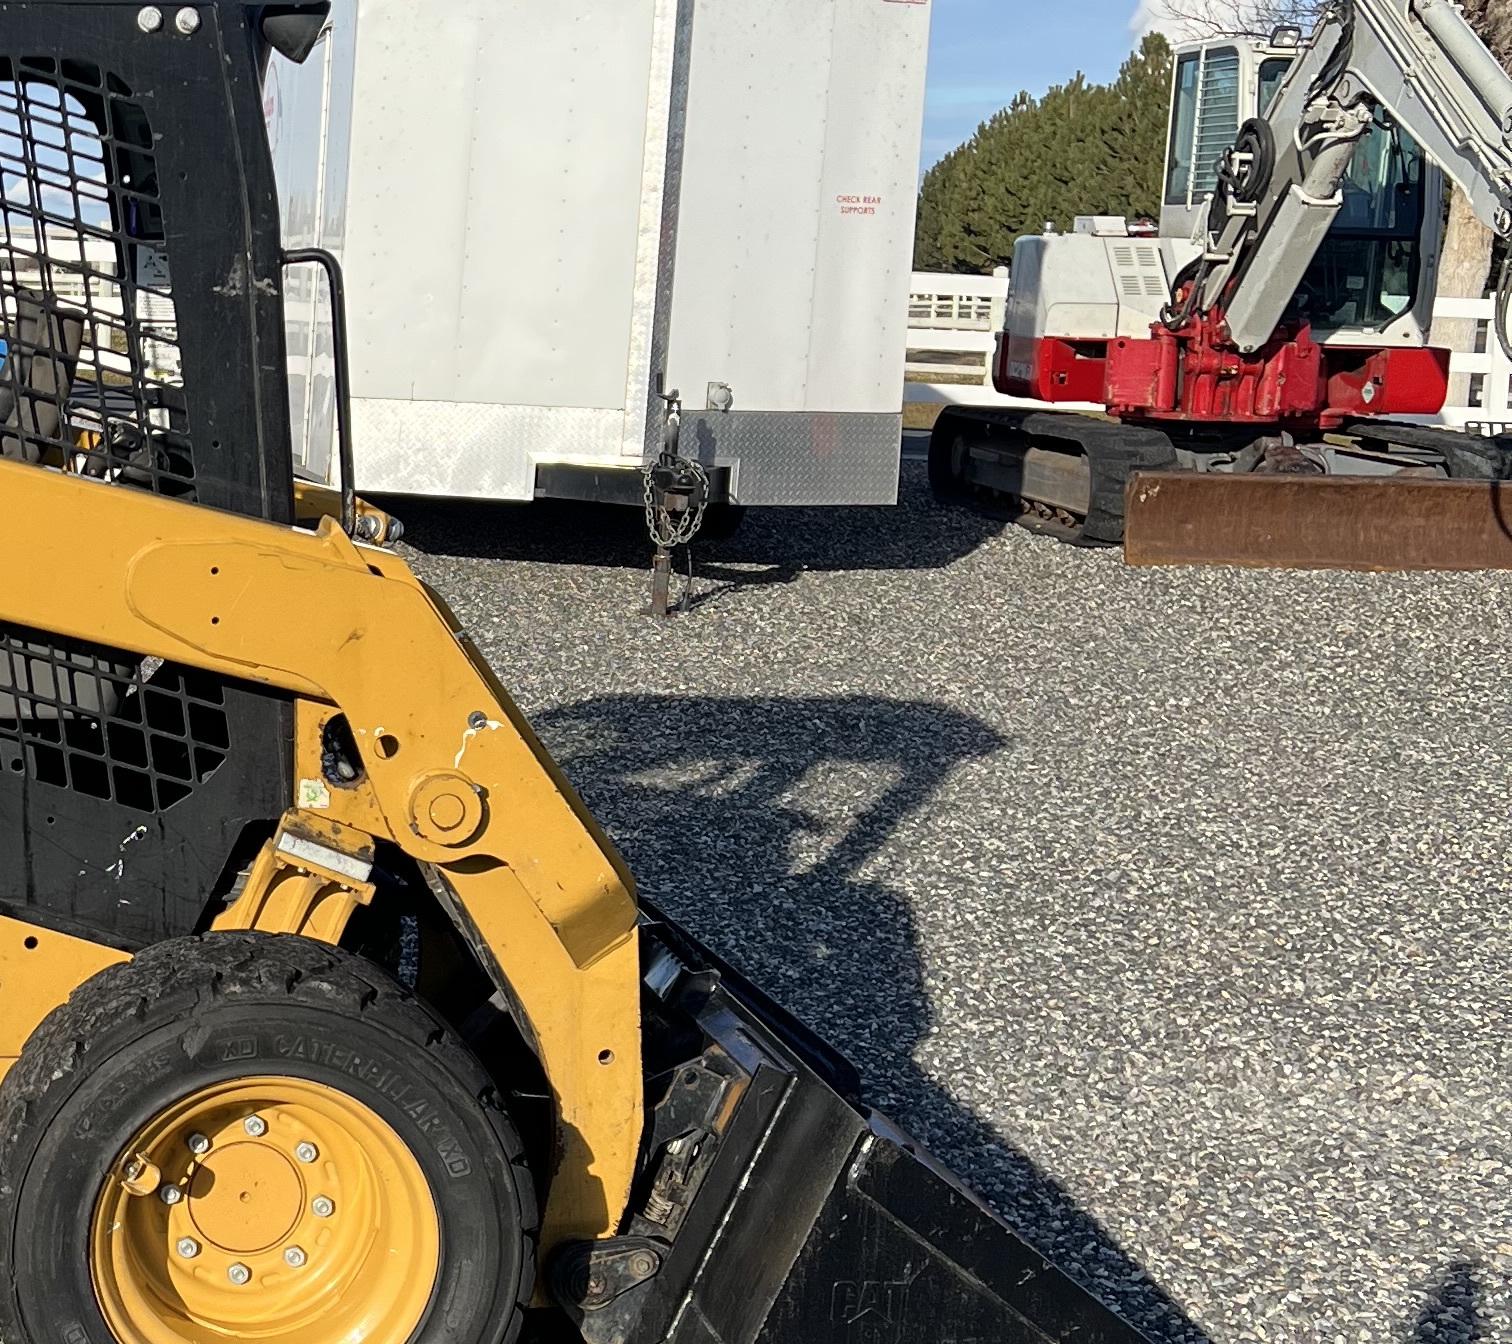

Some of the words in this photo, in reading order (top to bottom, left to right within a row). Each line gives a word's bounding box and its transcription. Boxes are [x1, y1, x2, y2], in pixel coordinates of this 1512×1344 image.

[219, 1038, 257, 1060] XD
[273, 1034, 441, 1135] CATERPILLAR
[439, 1141, 471, 1177] XD
[830, 1280, 909, 1325] CAT
